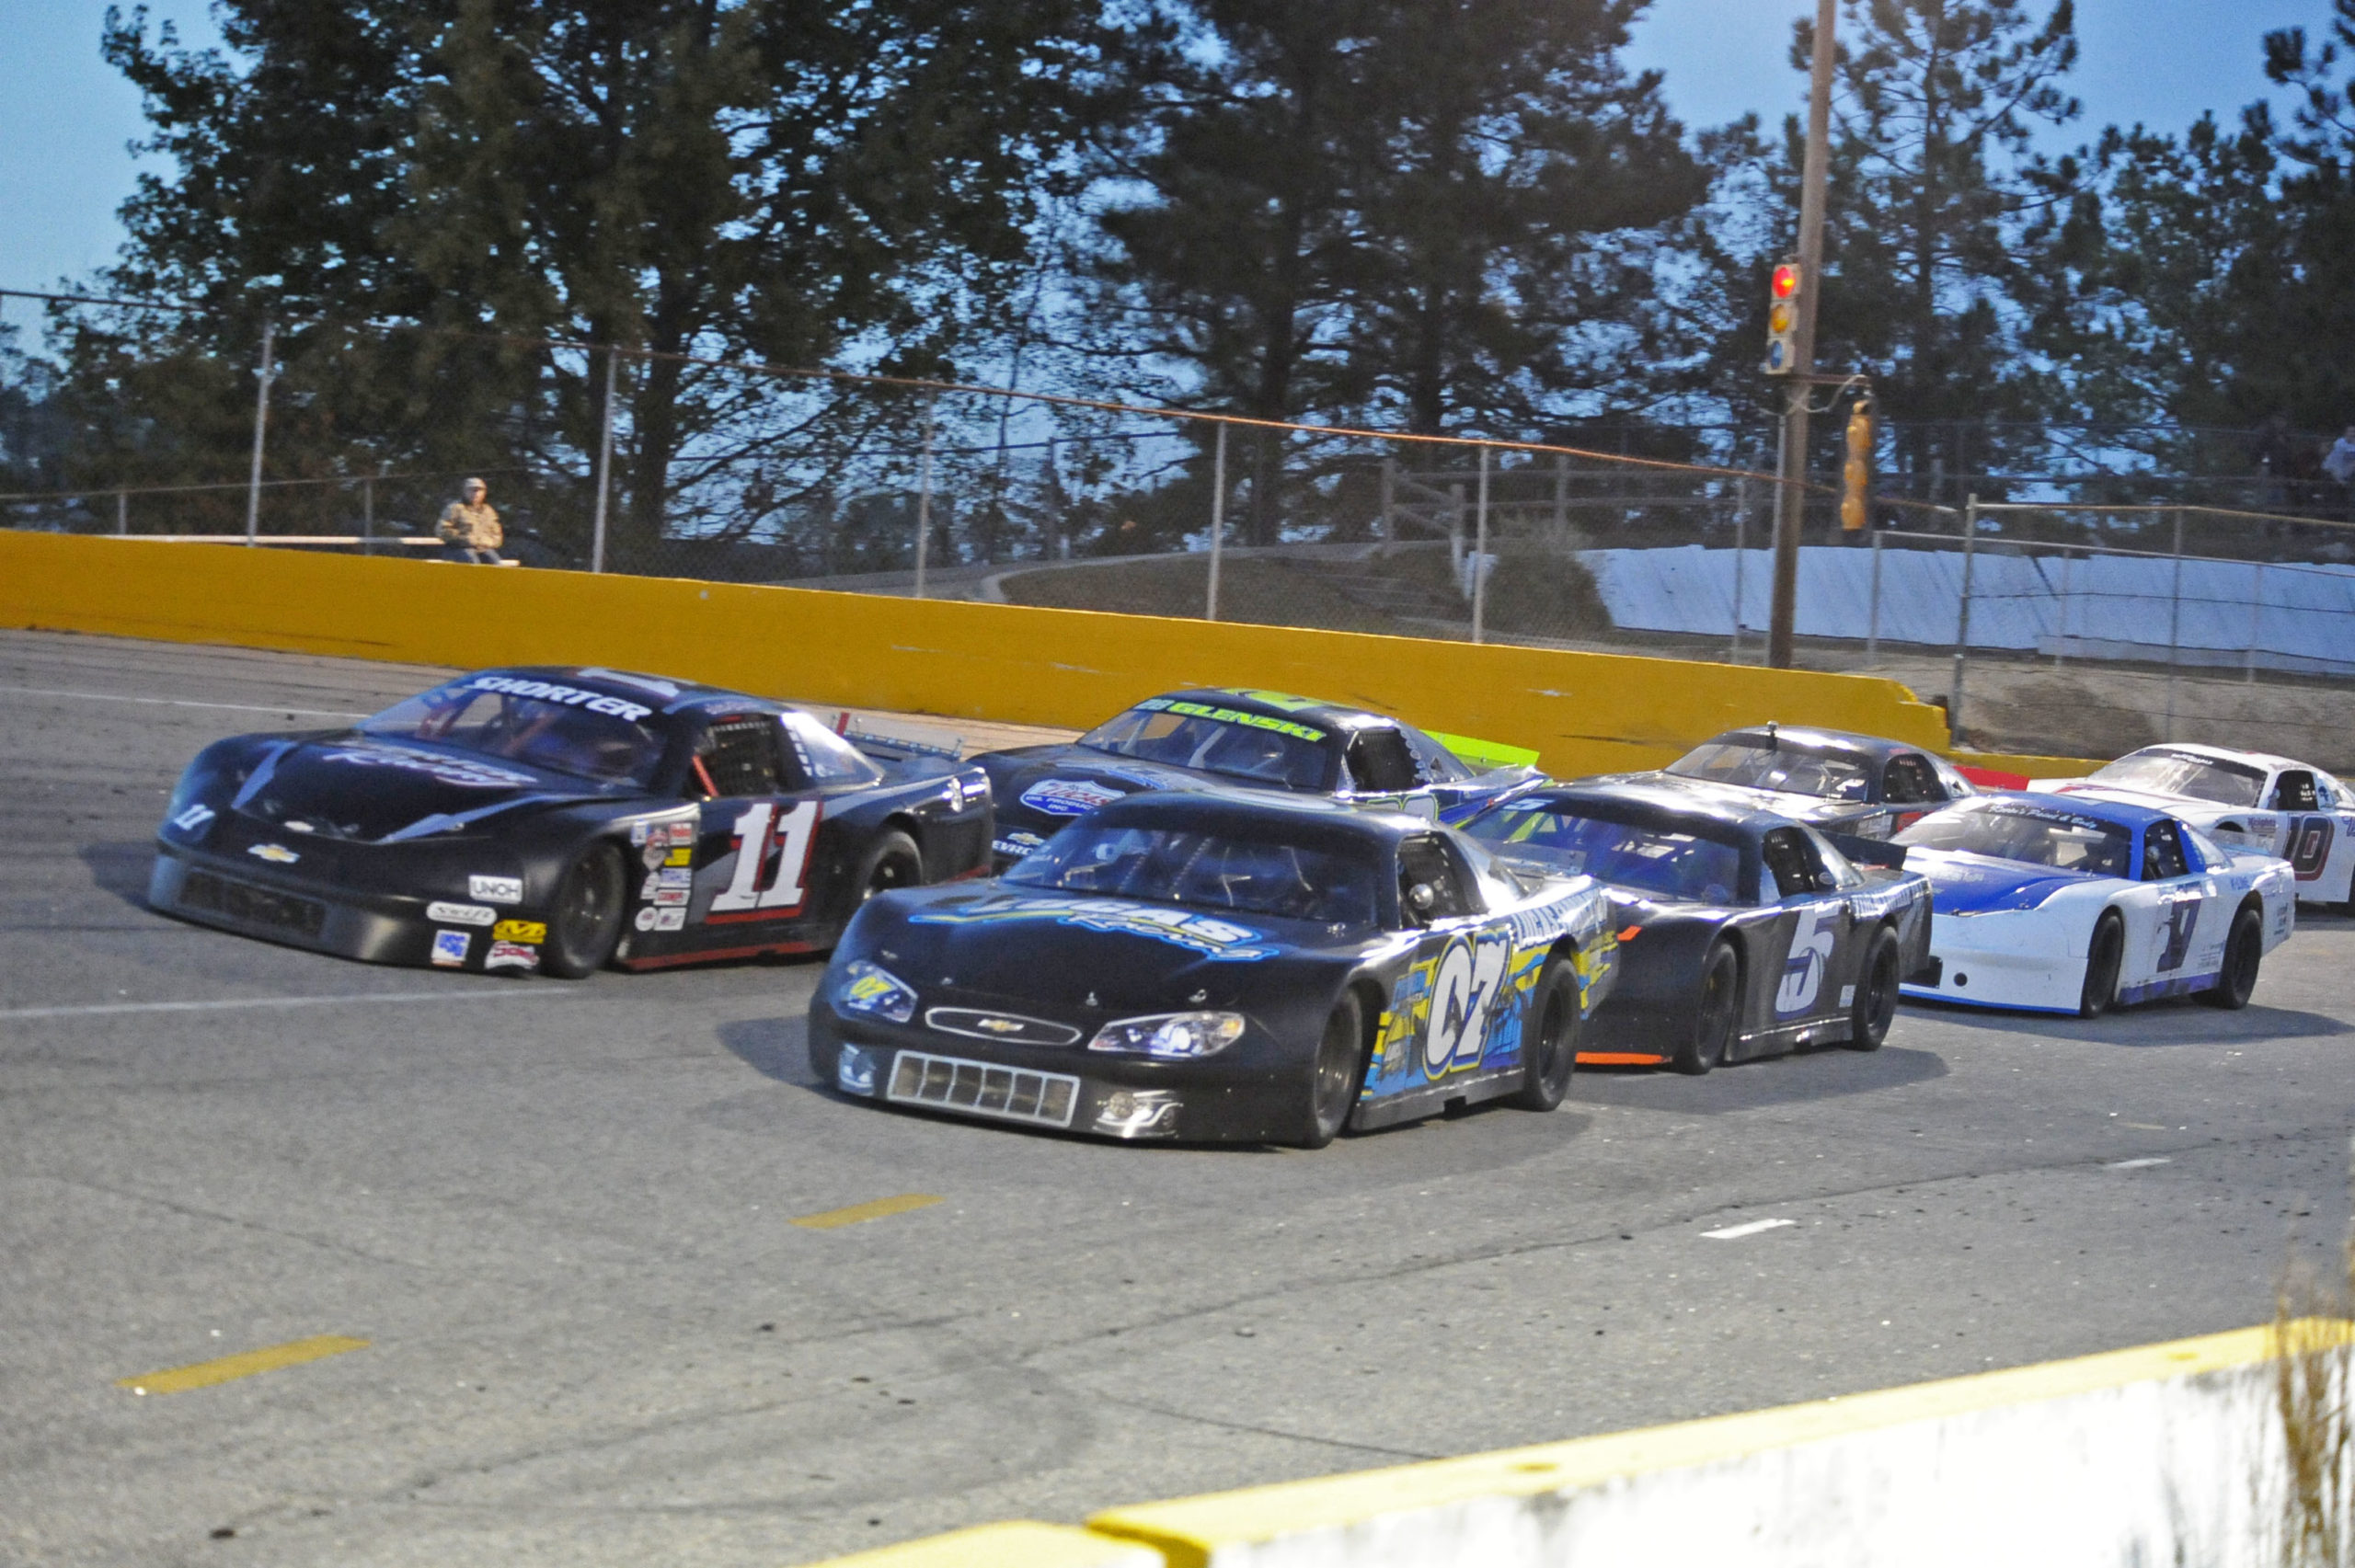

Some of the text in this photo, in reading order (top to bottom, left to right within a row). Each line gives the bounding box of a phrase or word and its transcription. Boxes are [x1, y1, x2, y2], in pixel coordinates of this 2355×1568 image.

[464, 677, 652, 722] SHORTER
[1167, 702, 1327, 742] GLENSKI
[1046, 797, 1095, 811] PRODUC
[708, 800, 819, 911] 11
[2281, 815, 2335, 881] 10
[473, 881, 519, 898] UNOH
[966, 898, 1255, 944] LUCAS
[1775, 900, 1841, 1013] 5
[850, 976, 891, 1000] 07
[1427, 938, 1509, 1066] 07
